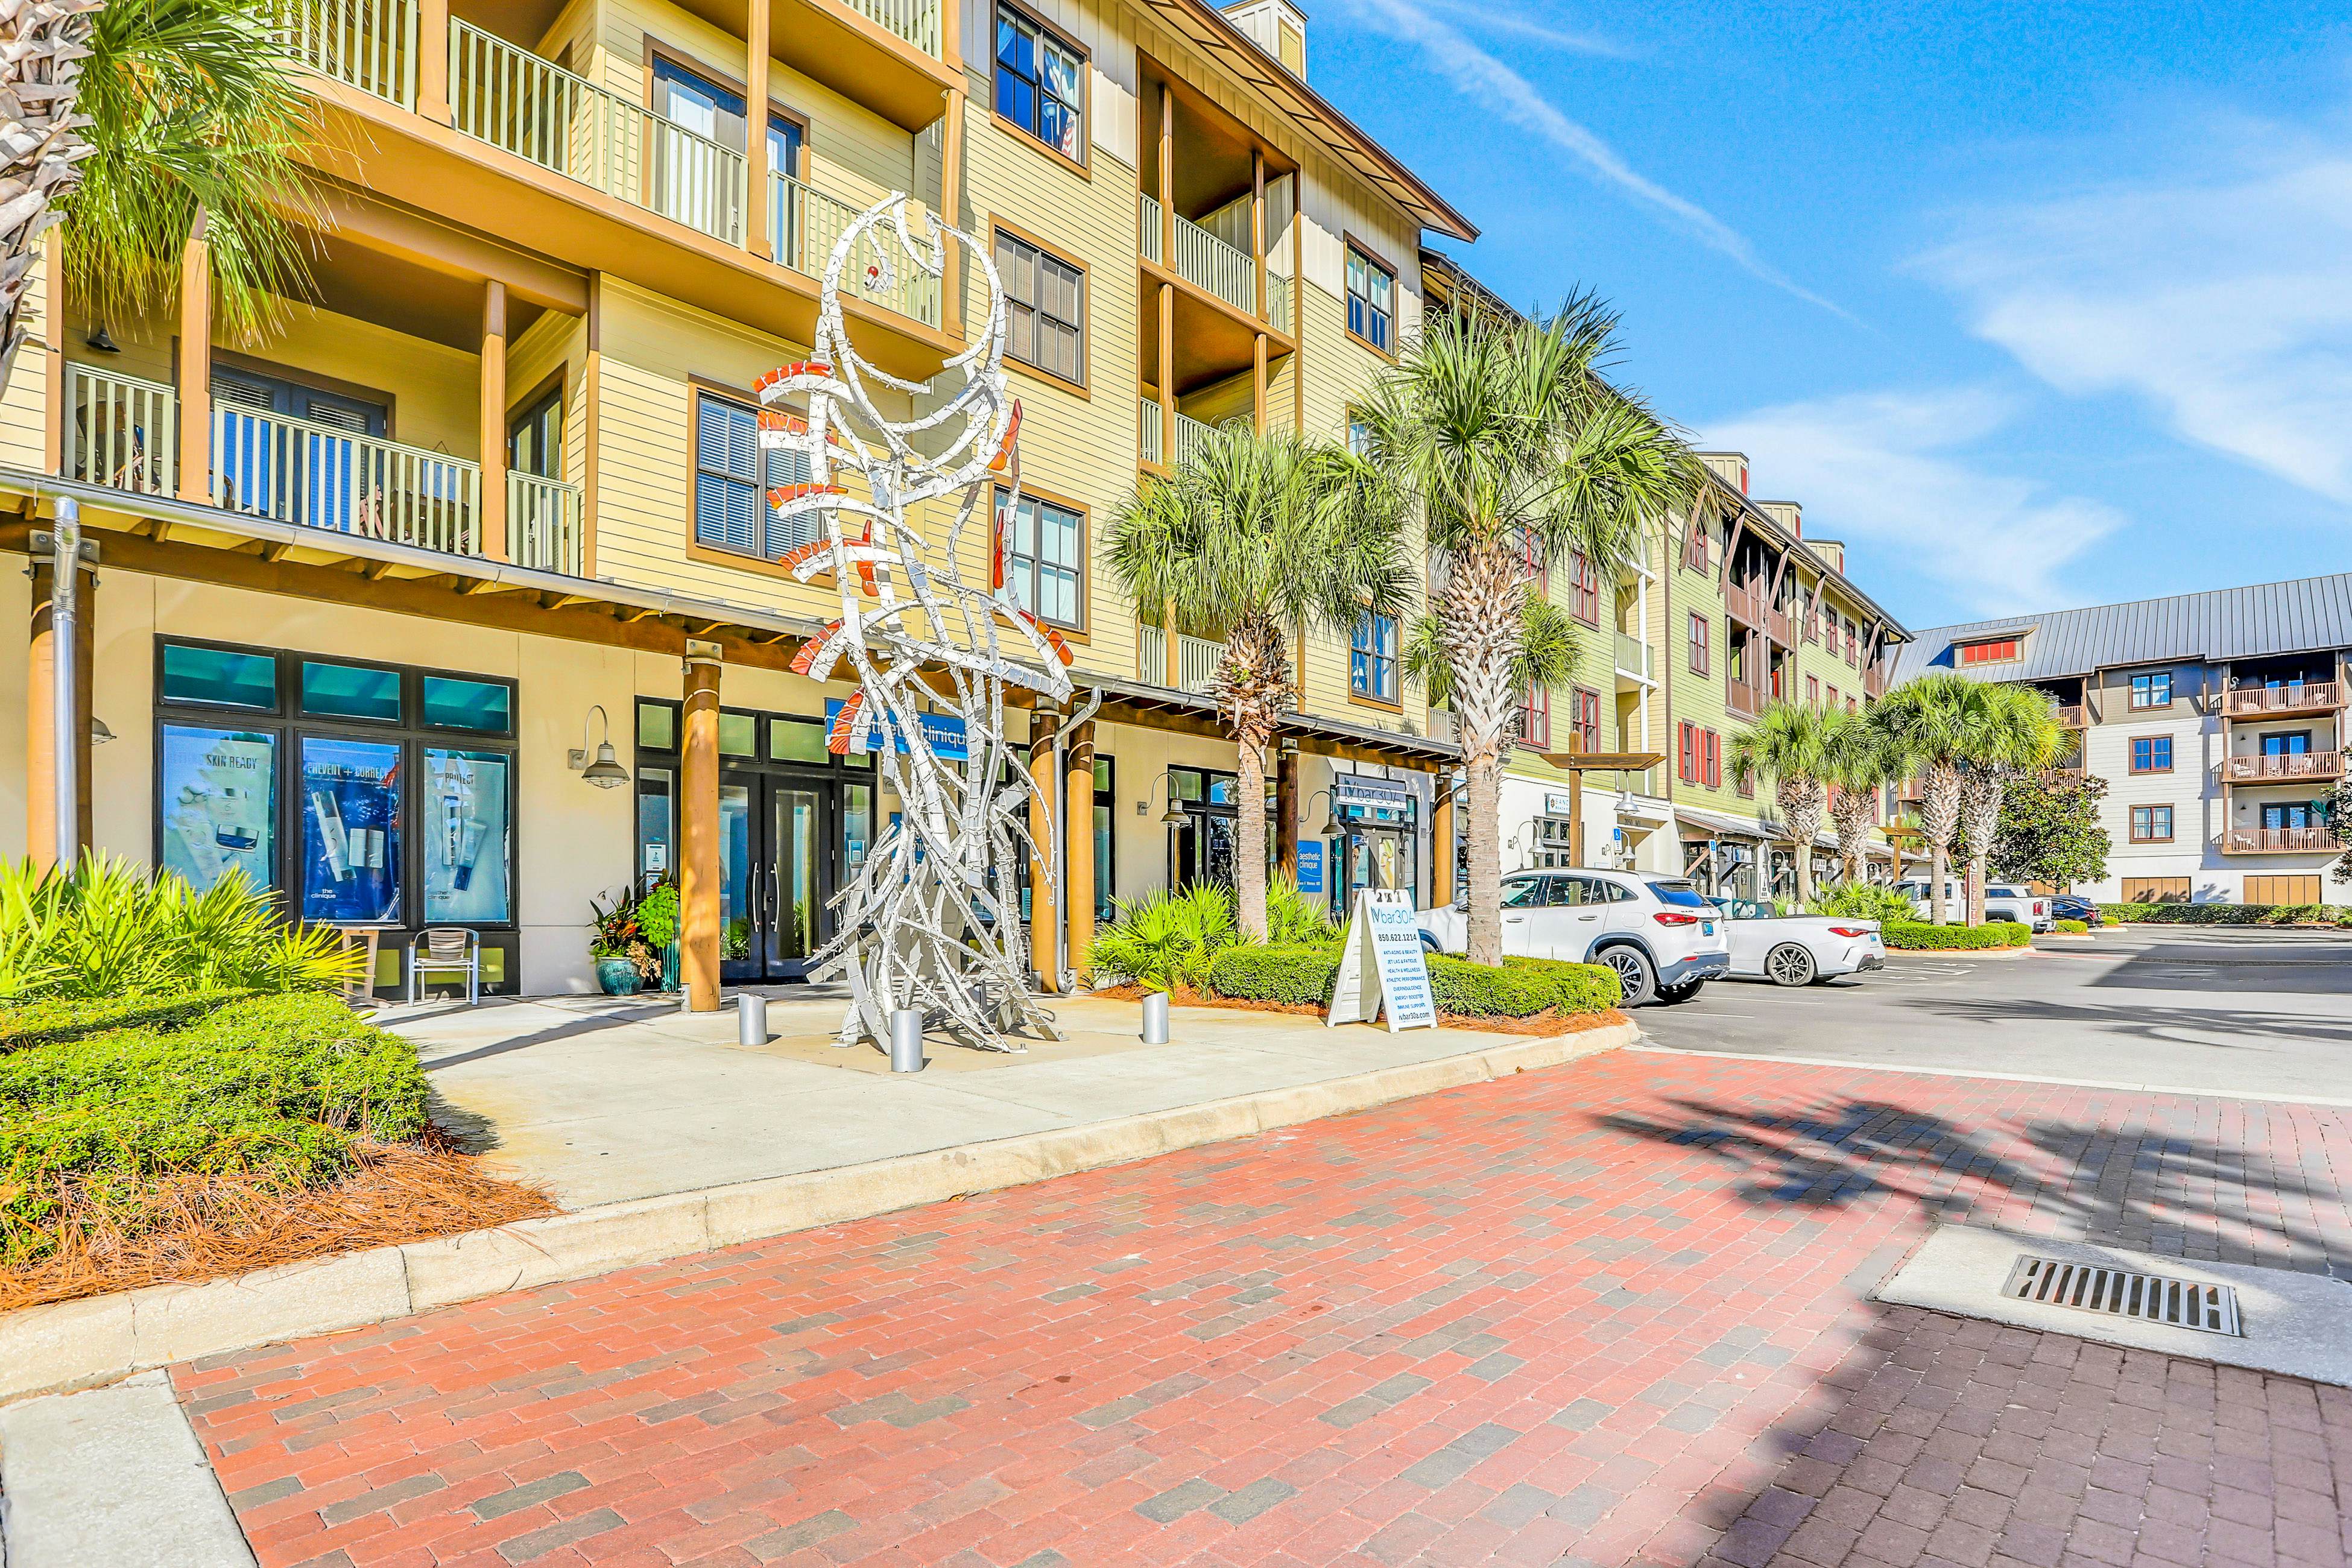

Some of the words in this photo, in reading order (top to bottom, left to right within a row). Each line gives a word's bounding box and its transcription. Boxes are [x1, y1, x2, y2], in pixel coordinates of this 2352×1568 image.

[922, 725, 966, 748] cliniqu
[207, 754, 226, 767] SKIN
[229, 756, 258, 769] READY
[308, 762, 340, 776] PREVENT
[1299, 852, 1321, 861] aesthetic
[1299, 860, 1318, 870] clinique
[1378, 933, 1417, 941] 850.622.1214
[1399, 1012, 1430, 1020] ivbar30a.com
